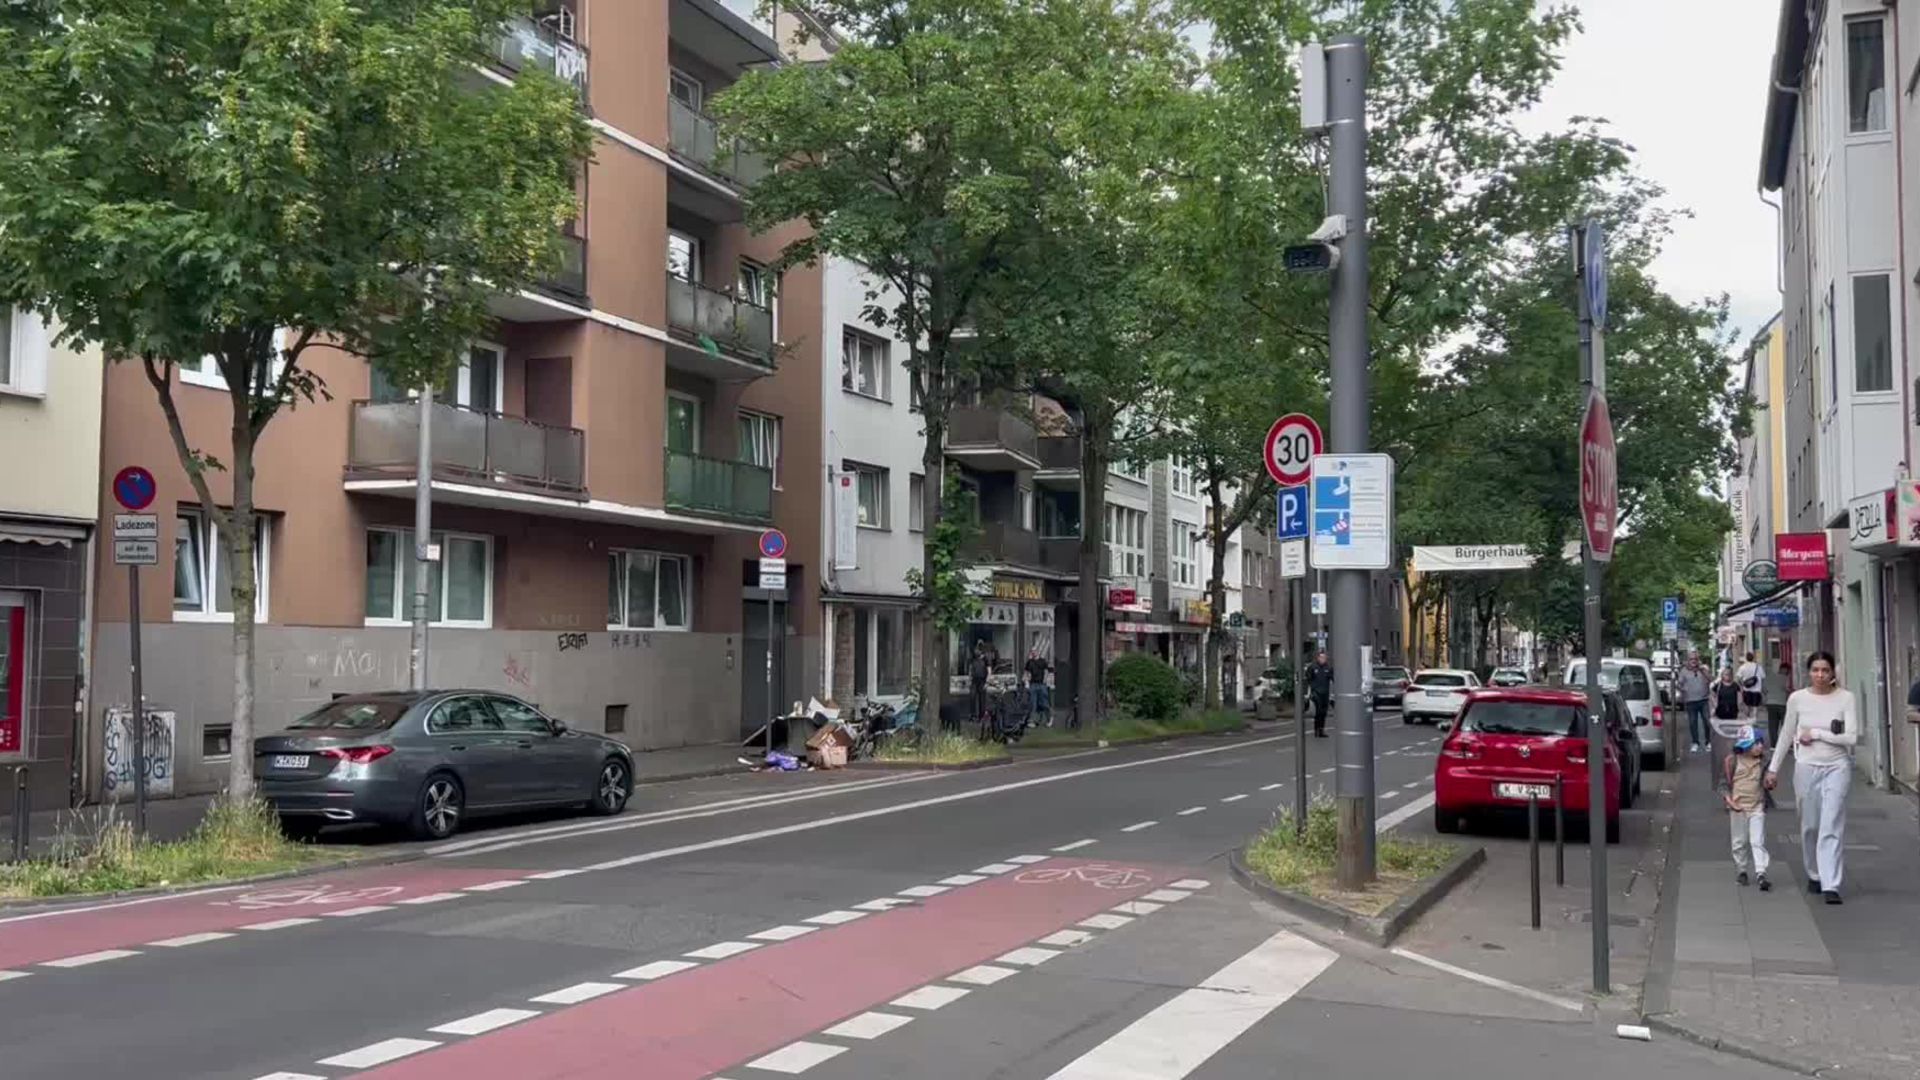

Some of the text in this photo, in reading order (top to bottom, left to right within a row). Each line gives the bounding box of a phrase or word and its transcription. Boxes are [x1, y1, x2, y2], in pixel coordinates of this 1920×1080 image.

[1278, 433, 1309, 466] 30
[1585, 440, 1614, 510] STOP
[115, 520, 156, 529] Ladezone
[1282, 493, 1298, 532] P
